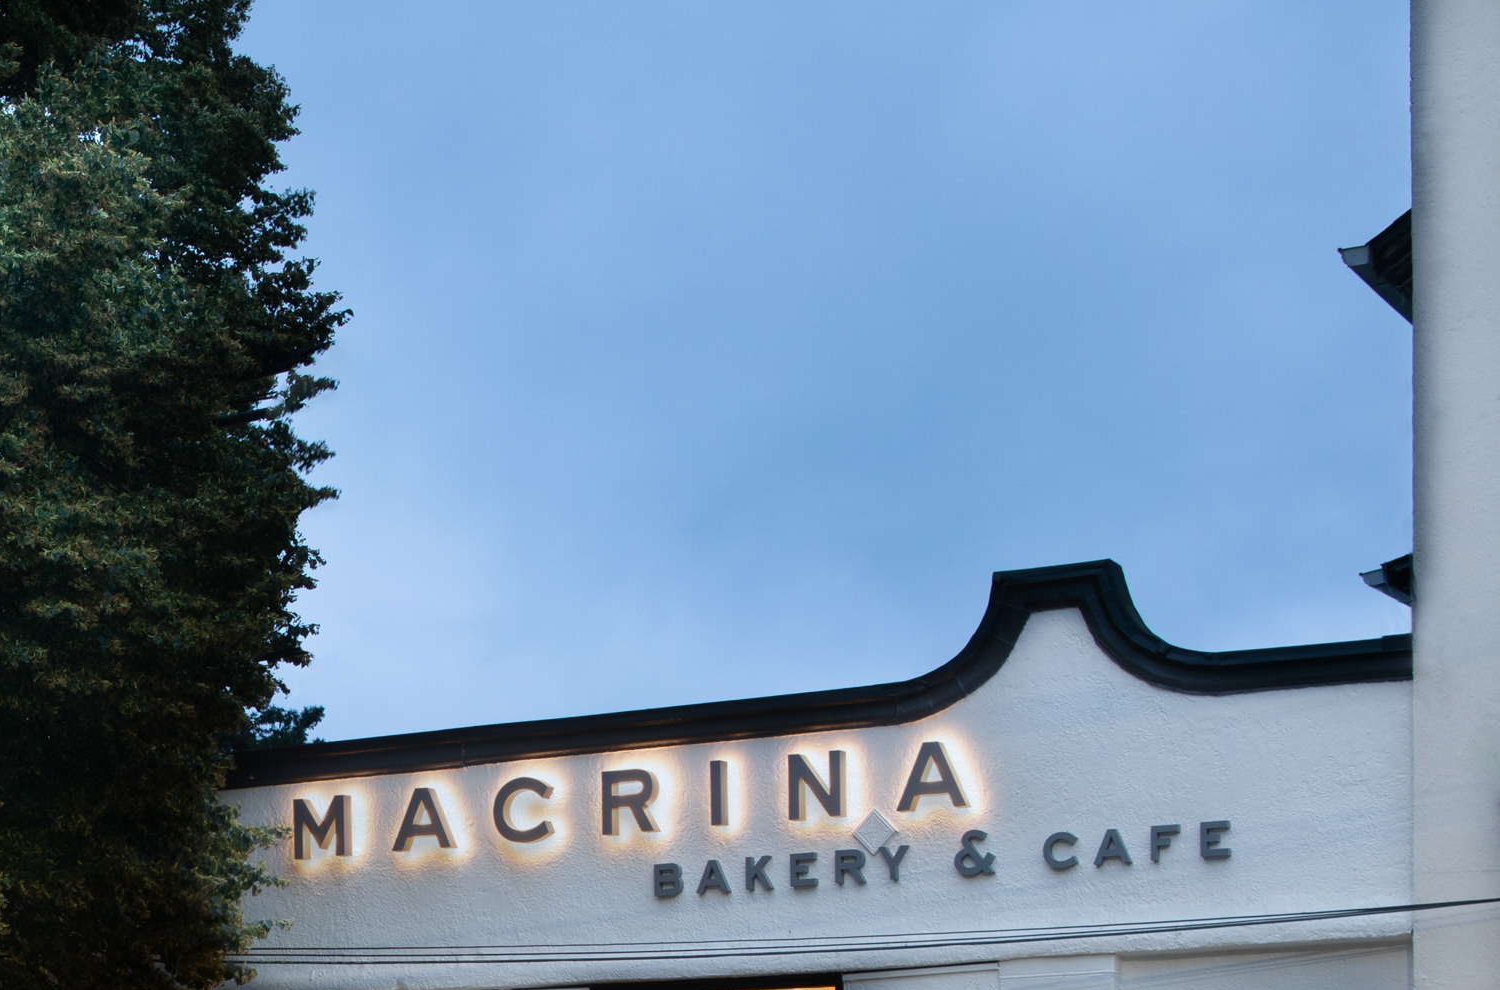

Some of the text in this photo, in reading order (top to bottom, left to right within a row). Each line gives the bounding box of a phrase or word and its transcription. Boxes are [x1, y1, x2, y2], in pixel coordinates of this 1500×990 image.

[293, 740, 971, 861] MACRINA
[653, 820, 1232, 897] BAKERY & CAFE
